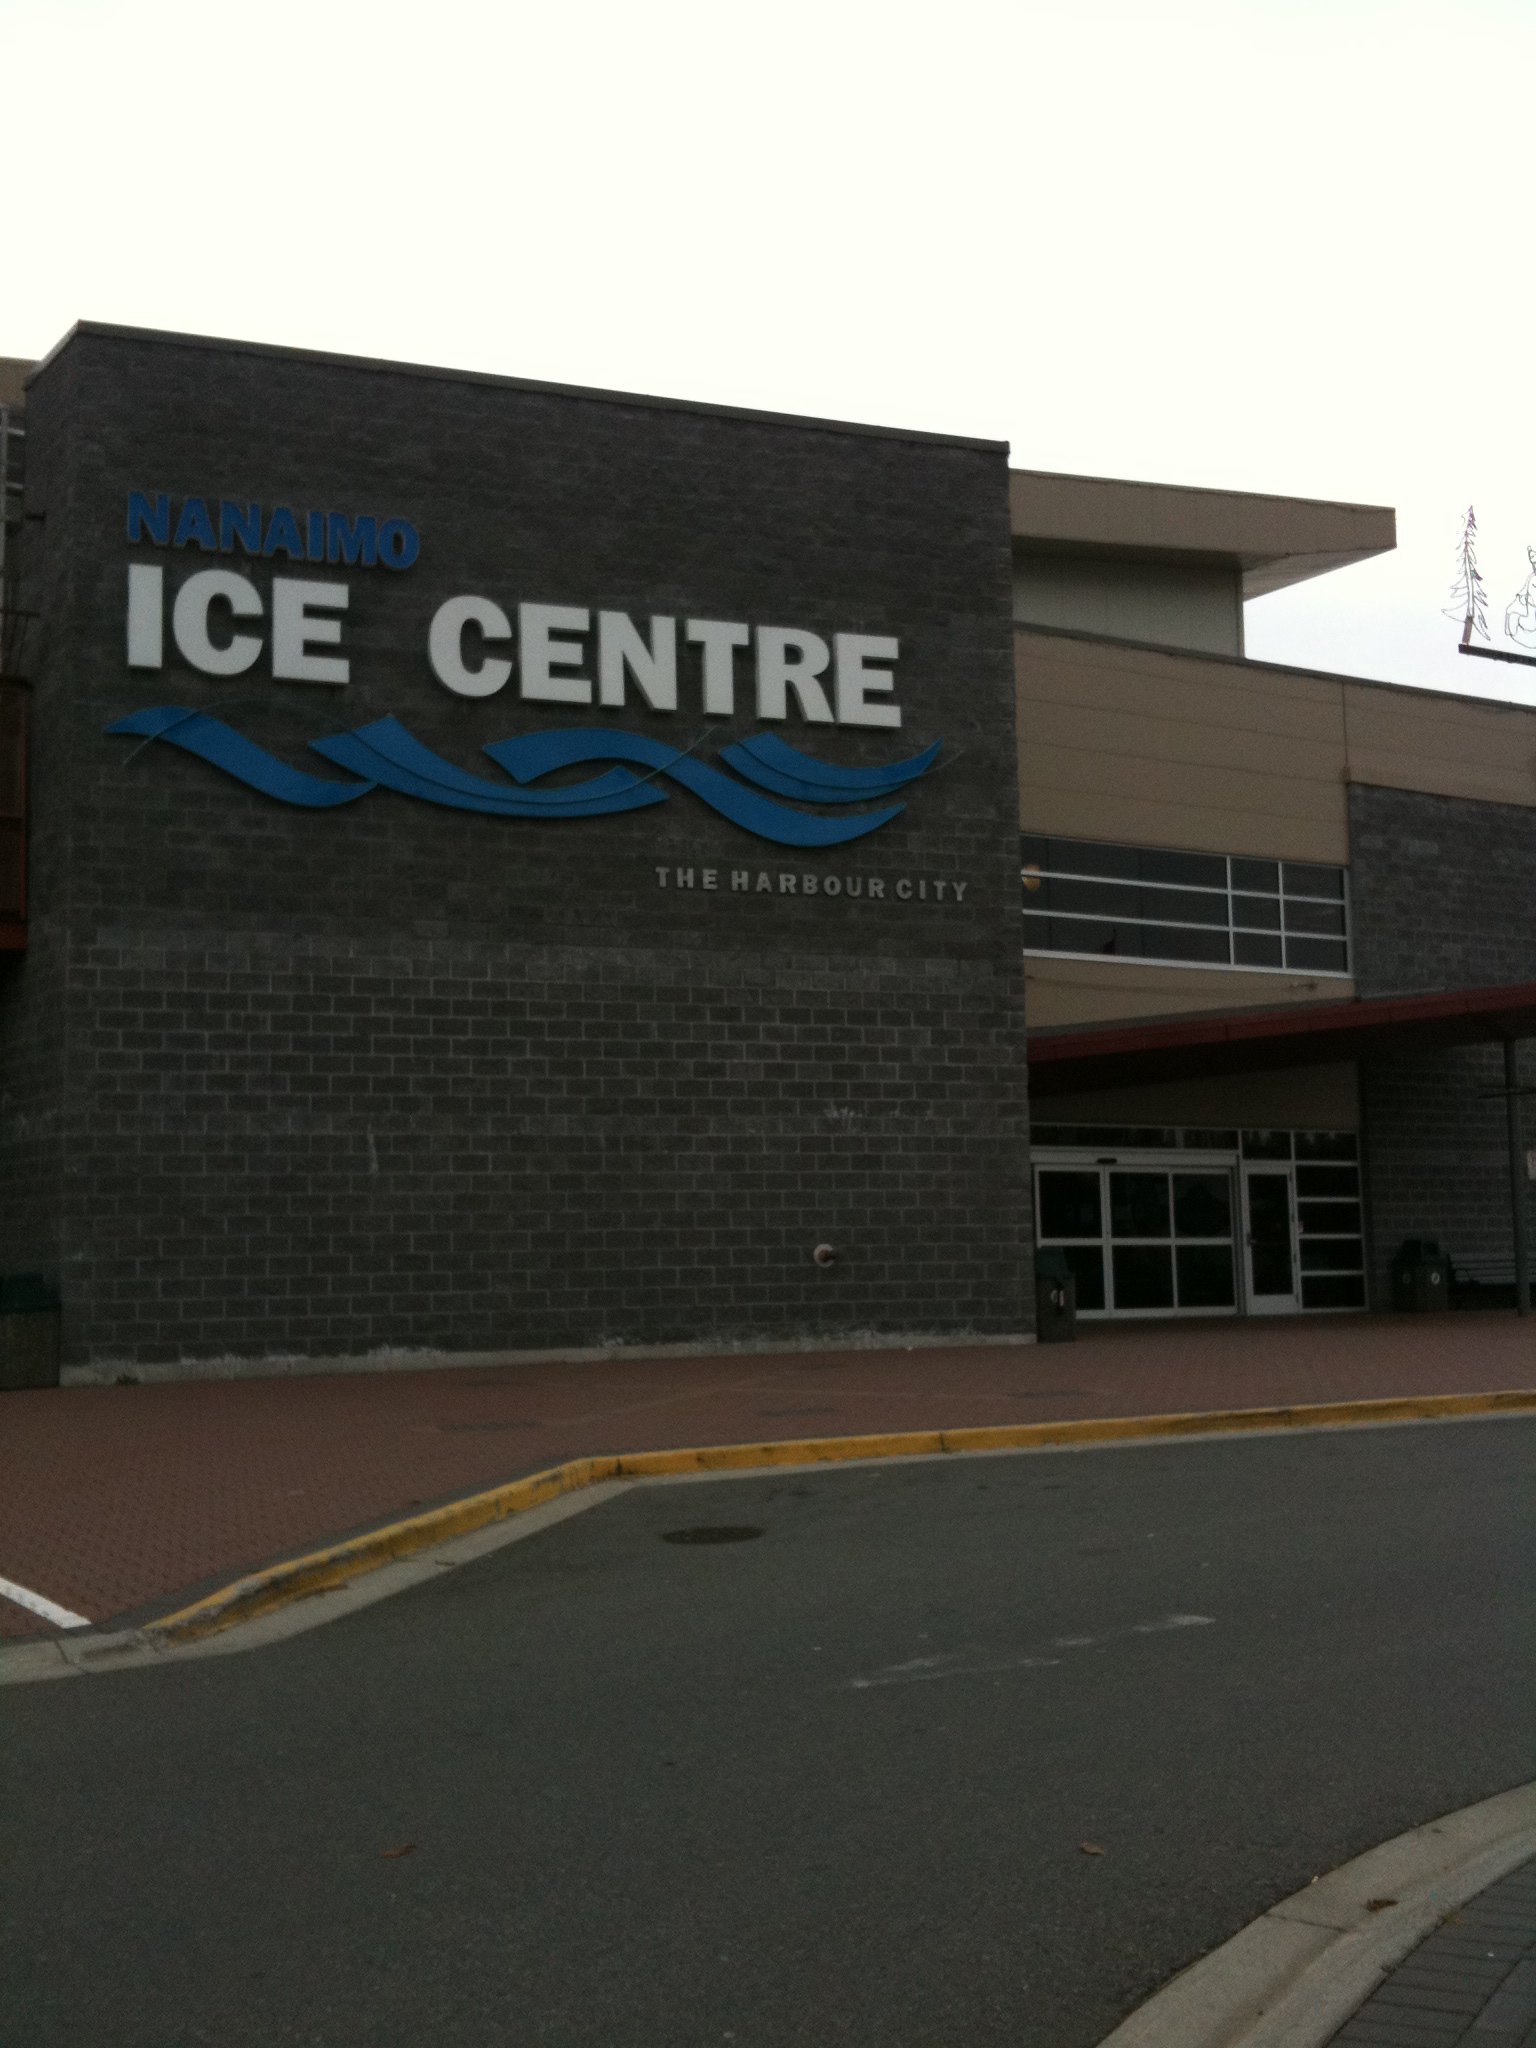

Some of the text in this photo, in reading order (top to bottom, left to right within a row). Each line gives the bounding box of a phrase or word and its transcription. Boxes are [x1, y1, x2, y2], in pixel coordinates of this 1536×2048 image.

[127, 491, 420, 570] NANAIMO
[127, 563, 901, 728] ICE CENTRE
[655, 867, 968, 902] THE HARBOUR CITY
